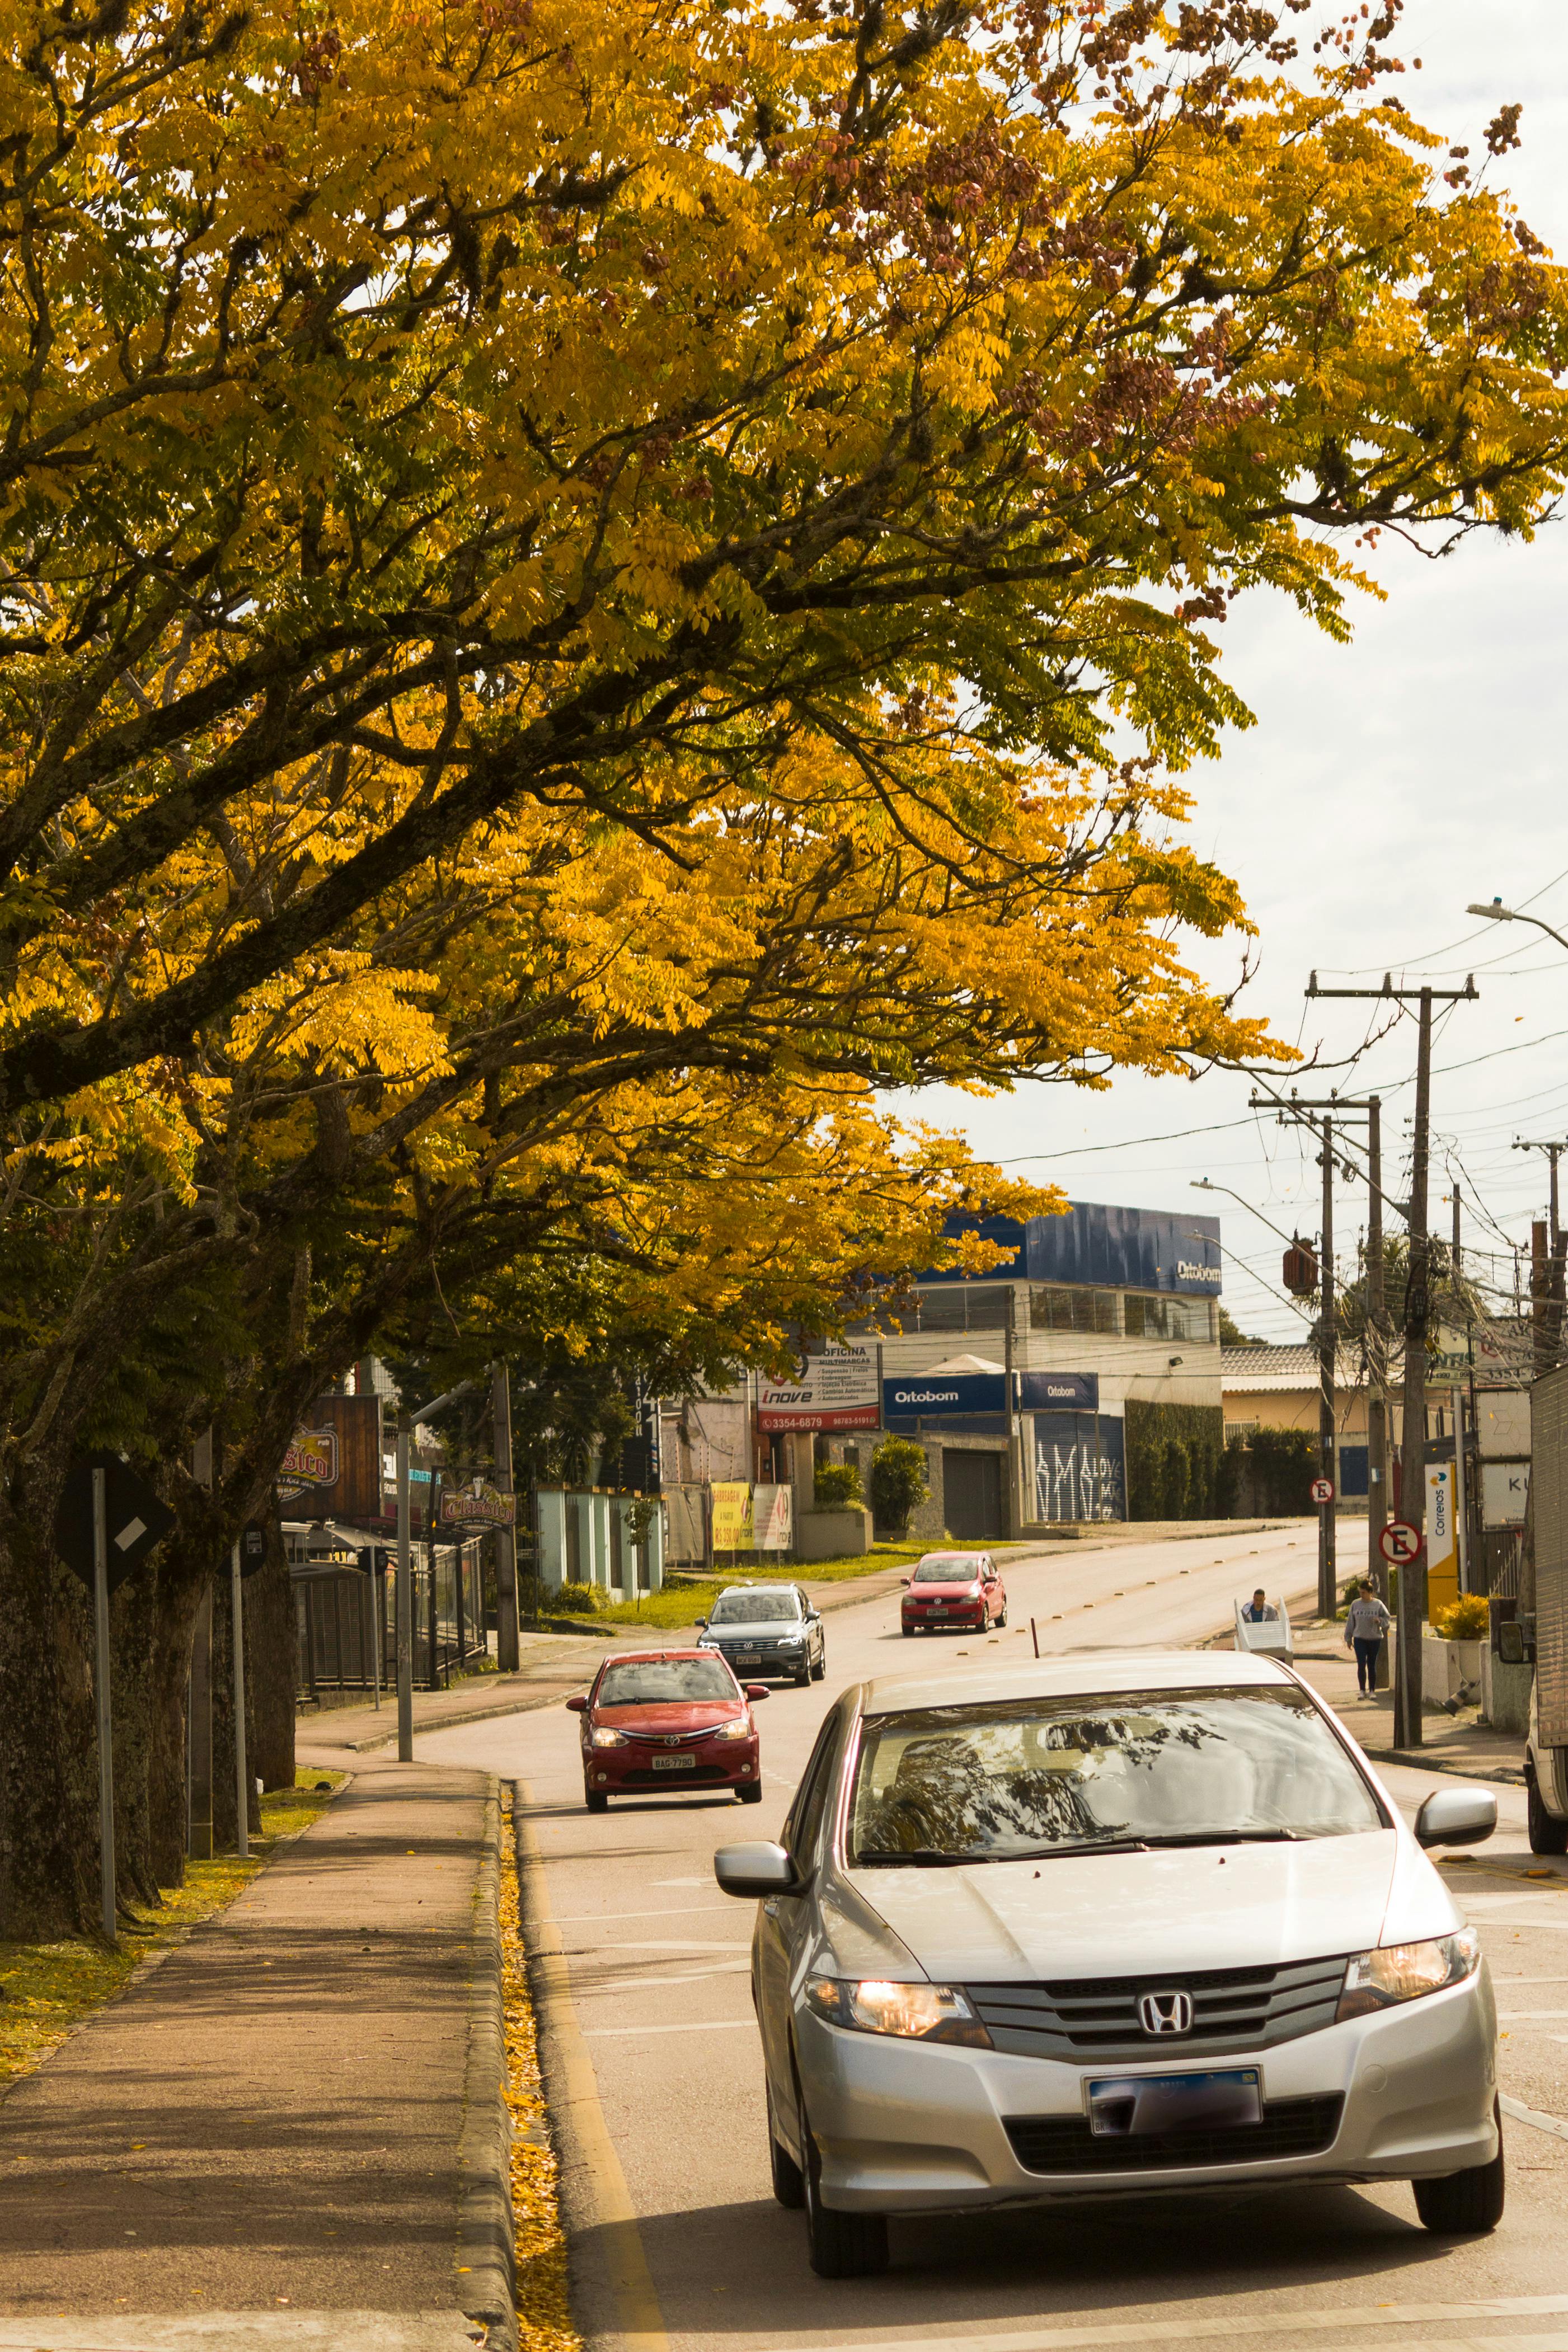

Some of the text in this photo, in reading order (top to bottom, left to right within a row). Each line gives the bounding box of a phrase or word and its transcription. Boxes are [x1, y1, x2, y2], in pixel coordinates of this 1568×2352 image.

[1177, 1261, 1222, 1282] Ortobom
[823, 1347, 866, 1356] OFICINA
[762, 1390, 813, 1404] inove
[895, 1391, 959, 1403] Ortobom
[1048, 1386, 1075, 1397] Ortobom
[773, 1417, 823, 1428] 3354-6879
[1318, 1483, 1327, 1498] E
[1435, 1489, 1445, 1536] Correios
[1392, 1530, 1408, 1555] E
[1095, 2122, 1106, 2132] BR
